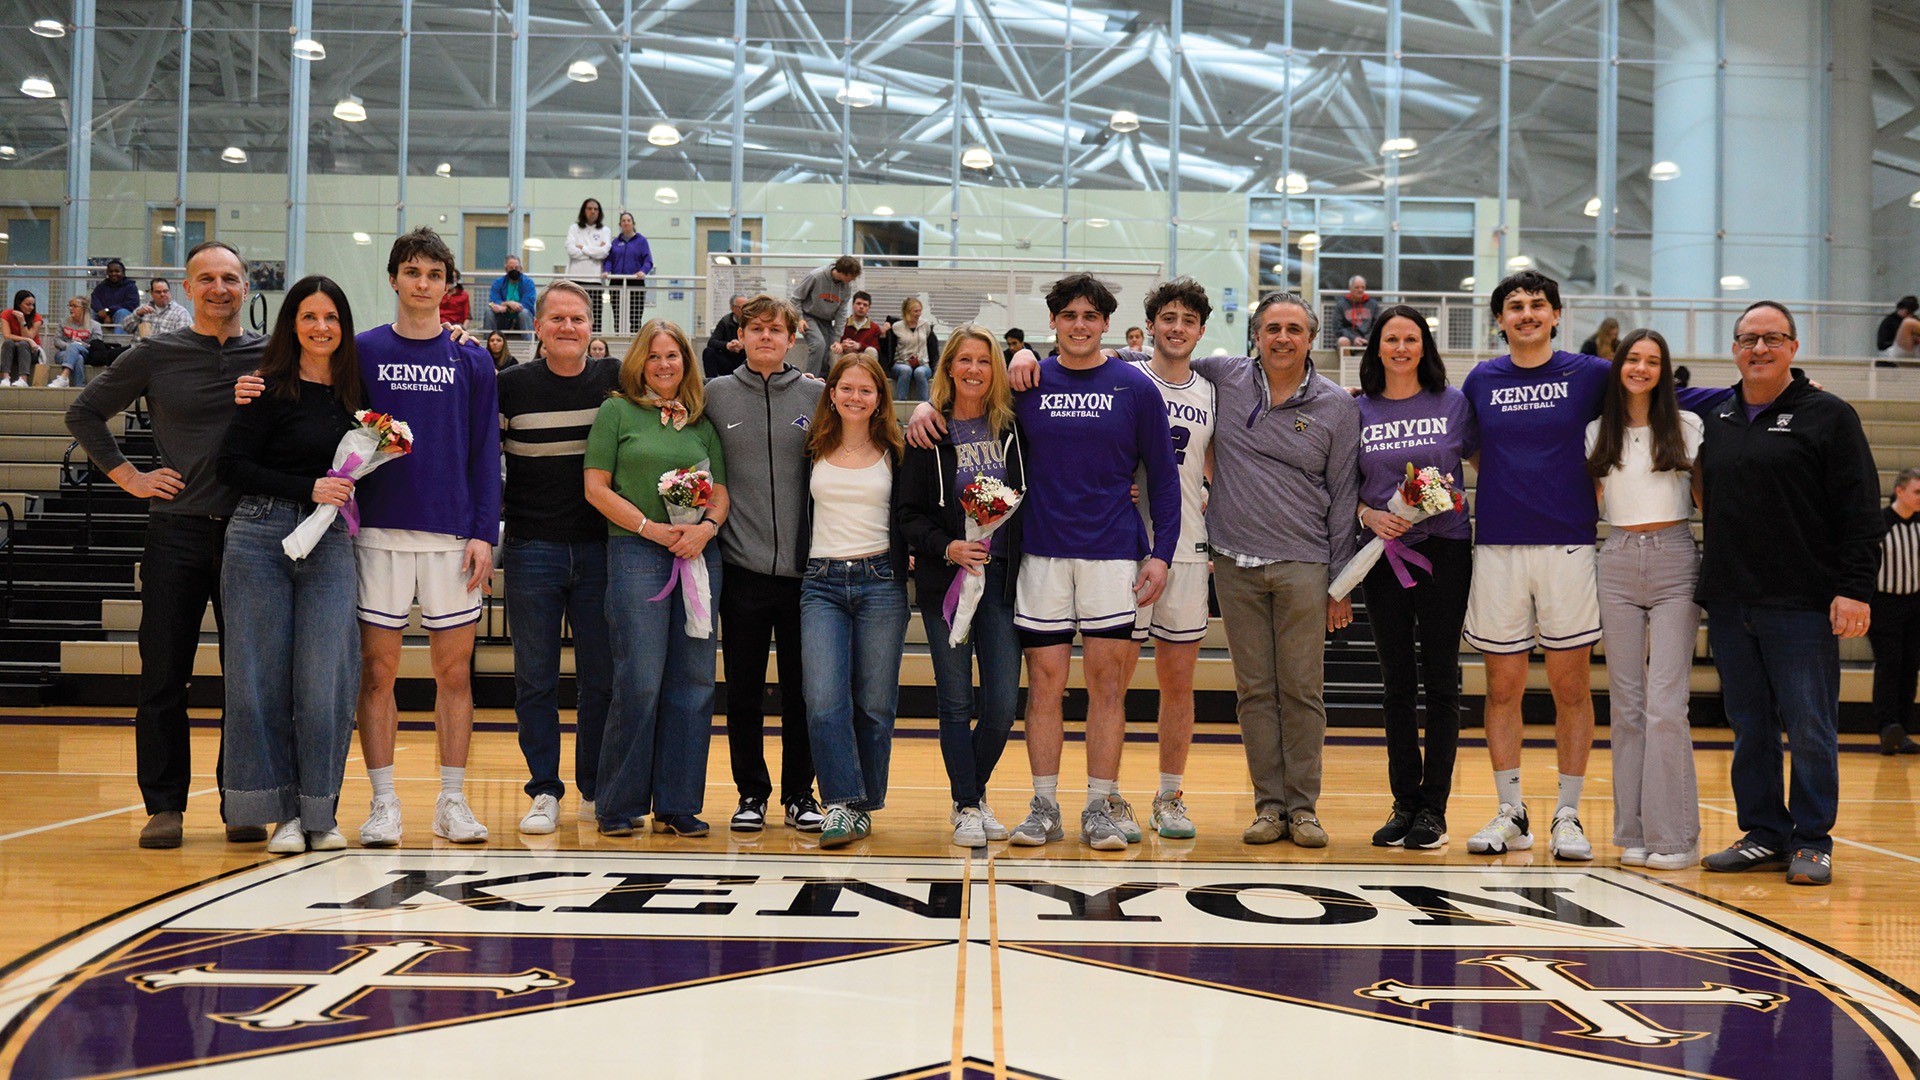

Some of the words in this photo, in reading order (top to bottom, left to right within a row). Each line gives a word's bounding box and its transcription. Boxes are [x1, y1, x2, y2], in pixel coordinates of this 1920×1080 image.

[377, 364, 456, 384] KENYON
[390, 383, 443, 392] BASKETBALL
[1490, 382, 1568, 405] KENYON
[1039, 393, 1114, 411] KENYON
[1501, 401, 1555, 412] BASKETBALL
[1050, 410, 1100, 418] BASKETBALL
[1360, 417, 1447, 448] KENYON
[954, 440, 1005, 468] ENYO
[1365, 437, 1437, 453] BASKETBALL
[962, 463, 1004, 473] COLLEGE
[305, 869, 1626, 928] KENYON
